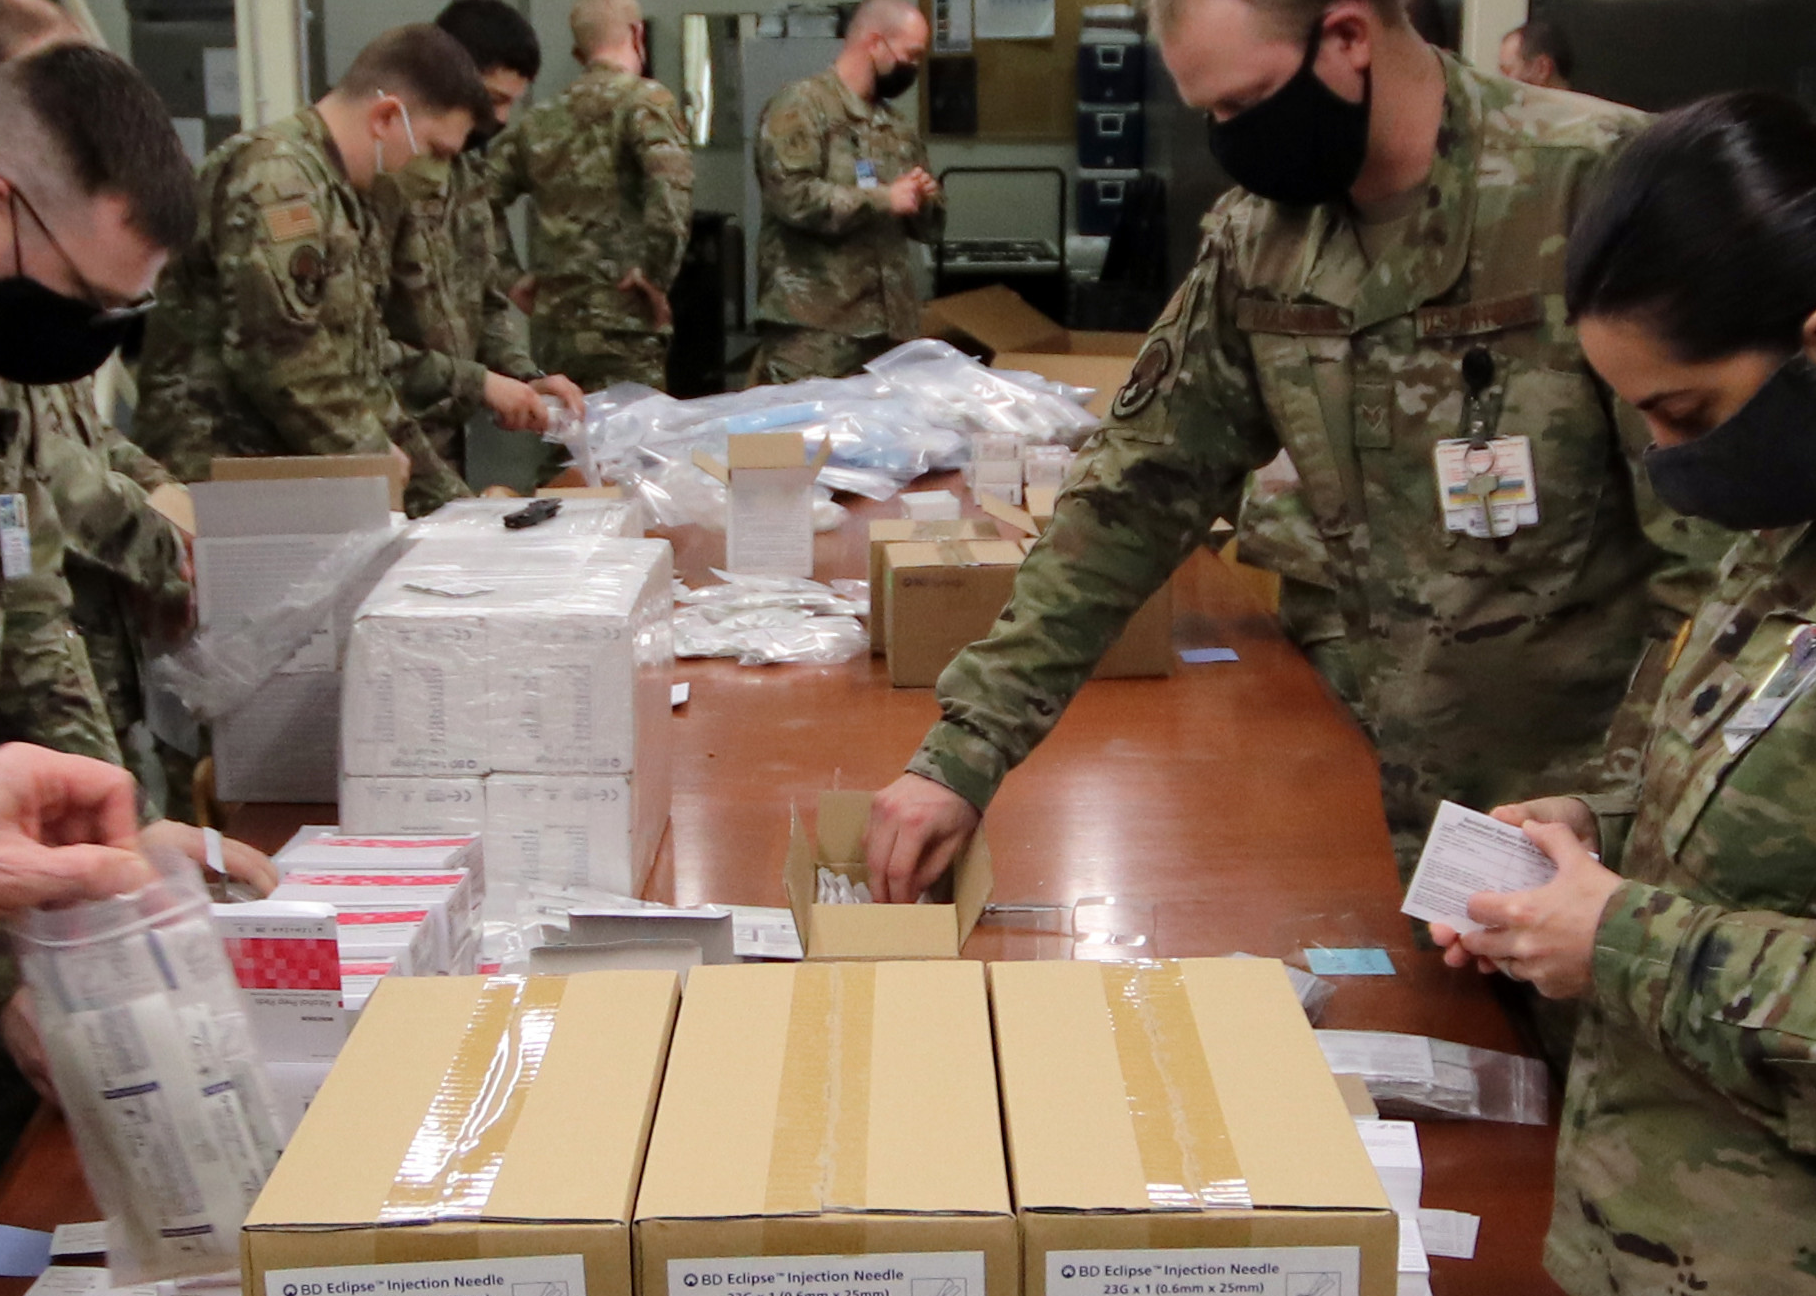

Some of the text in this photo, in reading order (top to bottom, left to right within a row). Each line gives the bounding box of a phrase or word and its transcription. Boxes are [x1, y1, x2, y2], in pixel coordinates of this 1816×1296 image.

[701, 1273, 722, 1285] BD
[787, 1270, 849, 1285] Injection
[854, 1268, 903, 1281] Needle
[1079, 1265, 1099, 1277] BD
[1164, 1263, 1225, 1278] Injection
[1230, 1262, 1279, 1274] Needle
[300, 1283, 322, 1295] BD
[387, 1276, 449, 1293] Injection
[453, 1273, 504, 1287] Needle
[1103, 1284, 1128, 1294] 23G
[1133, 1286, 1140, 1294] x
[1155, 1283, 1203, 1295] (0.6mm
[1219, 1282, 1264, 1294] 25mm)
